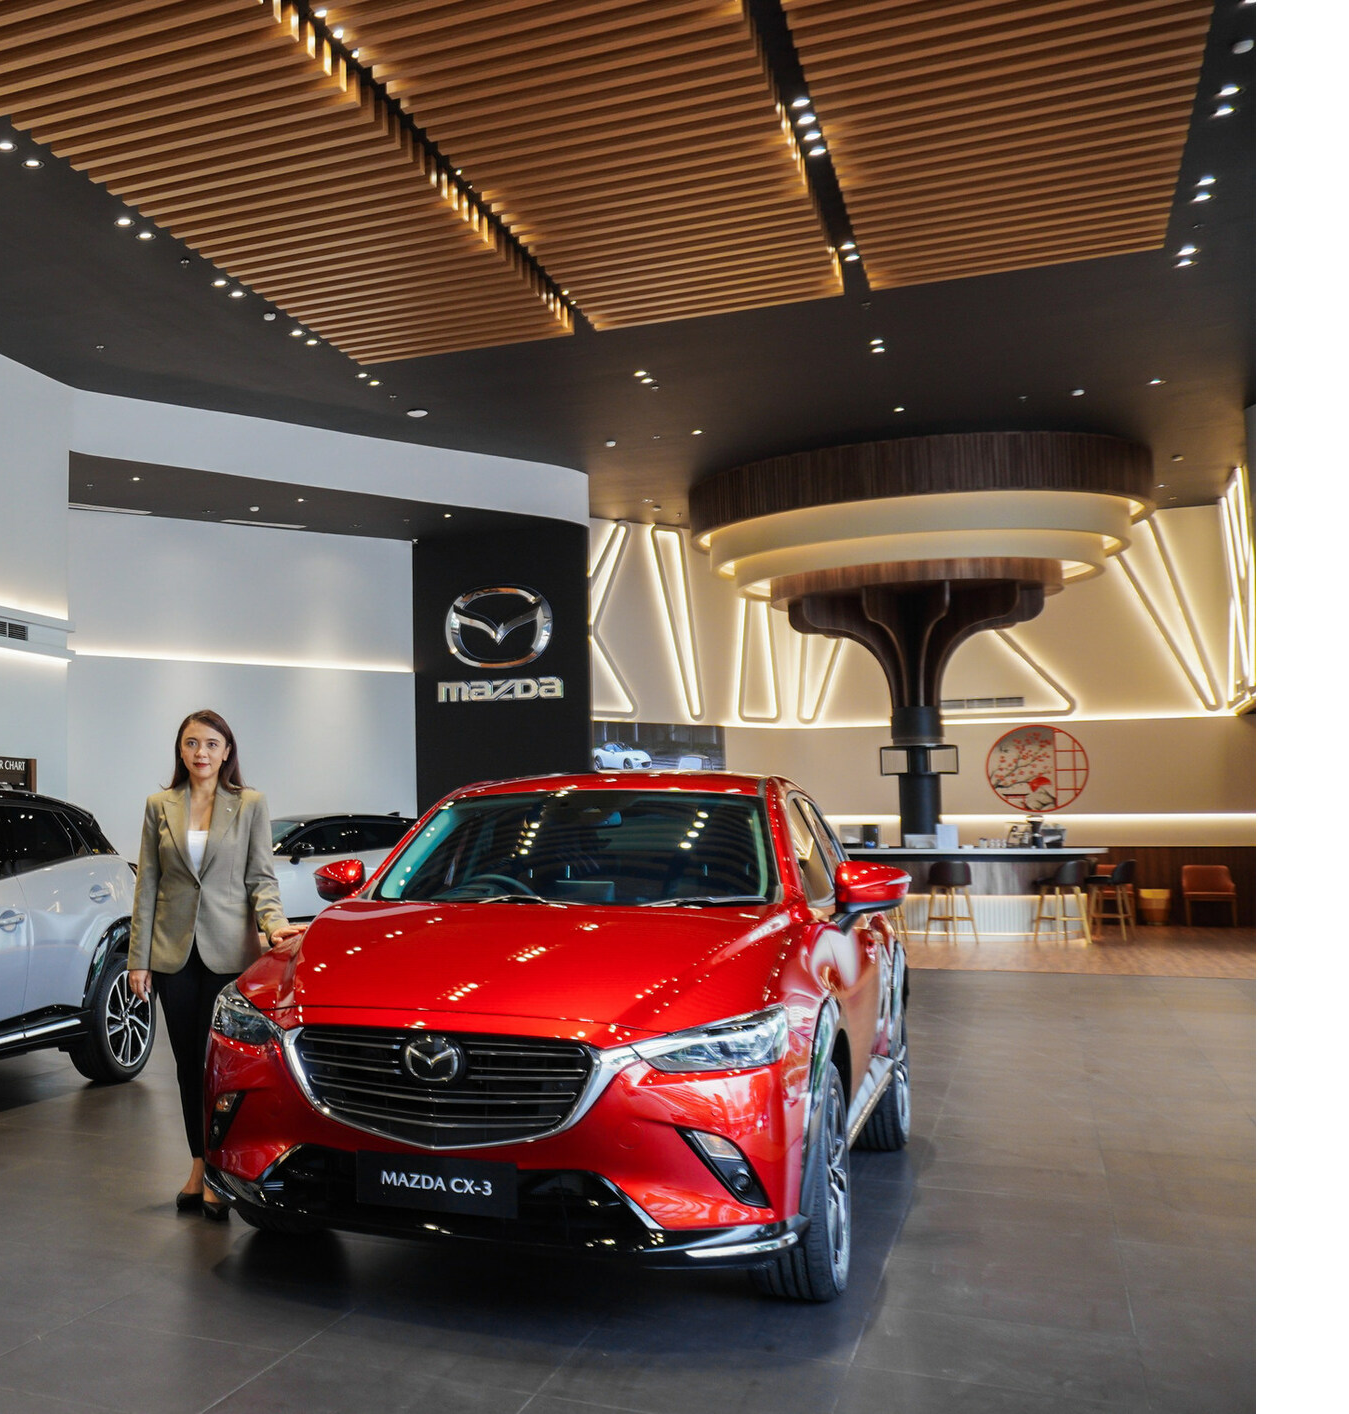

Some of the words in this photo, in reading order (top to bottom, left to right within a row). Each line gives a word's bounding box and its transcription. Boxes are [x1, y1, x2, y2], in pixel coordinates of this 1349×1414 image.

[4, 760, 26, 771] CHART
[380, 1170, 447, 1193] MAZDA
[450, 1177, 493, 1196] CX-3
